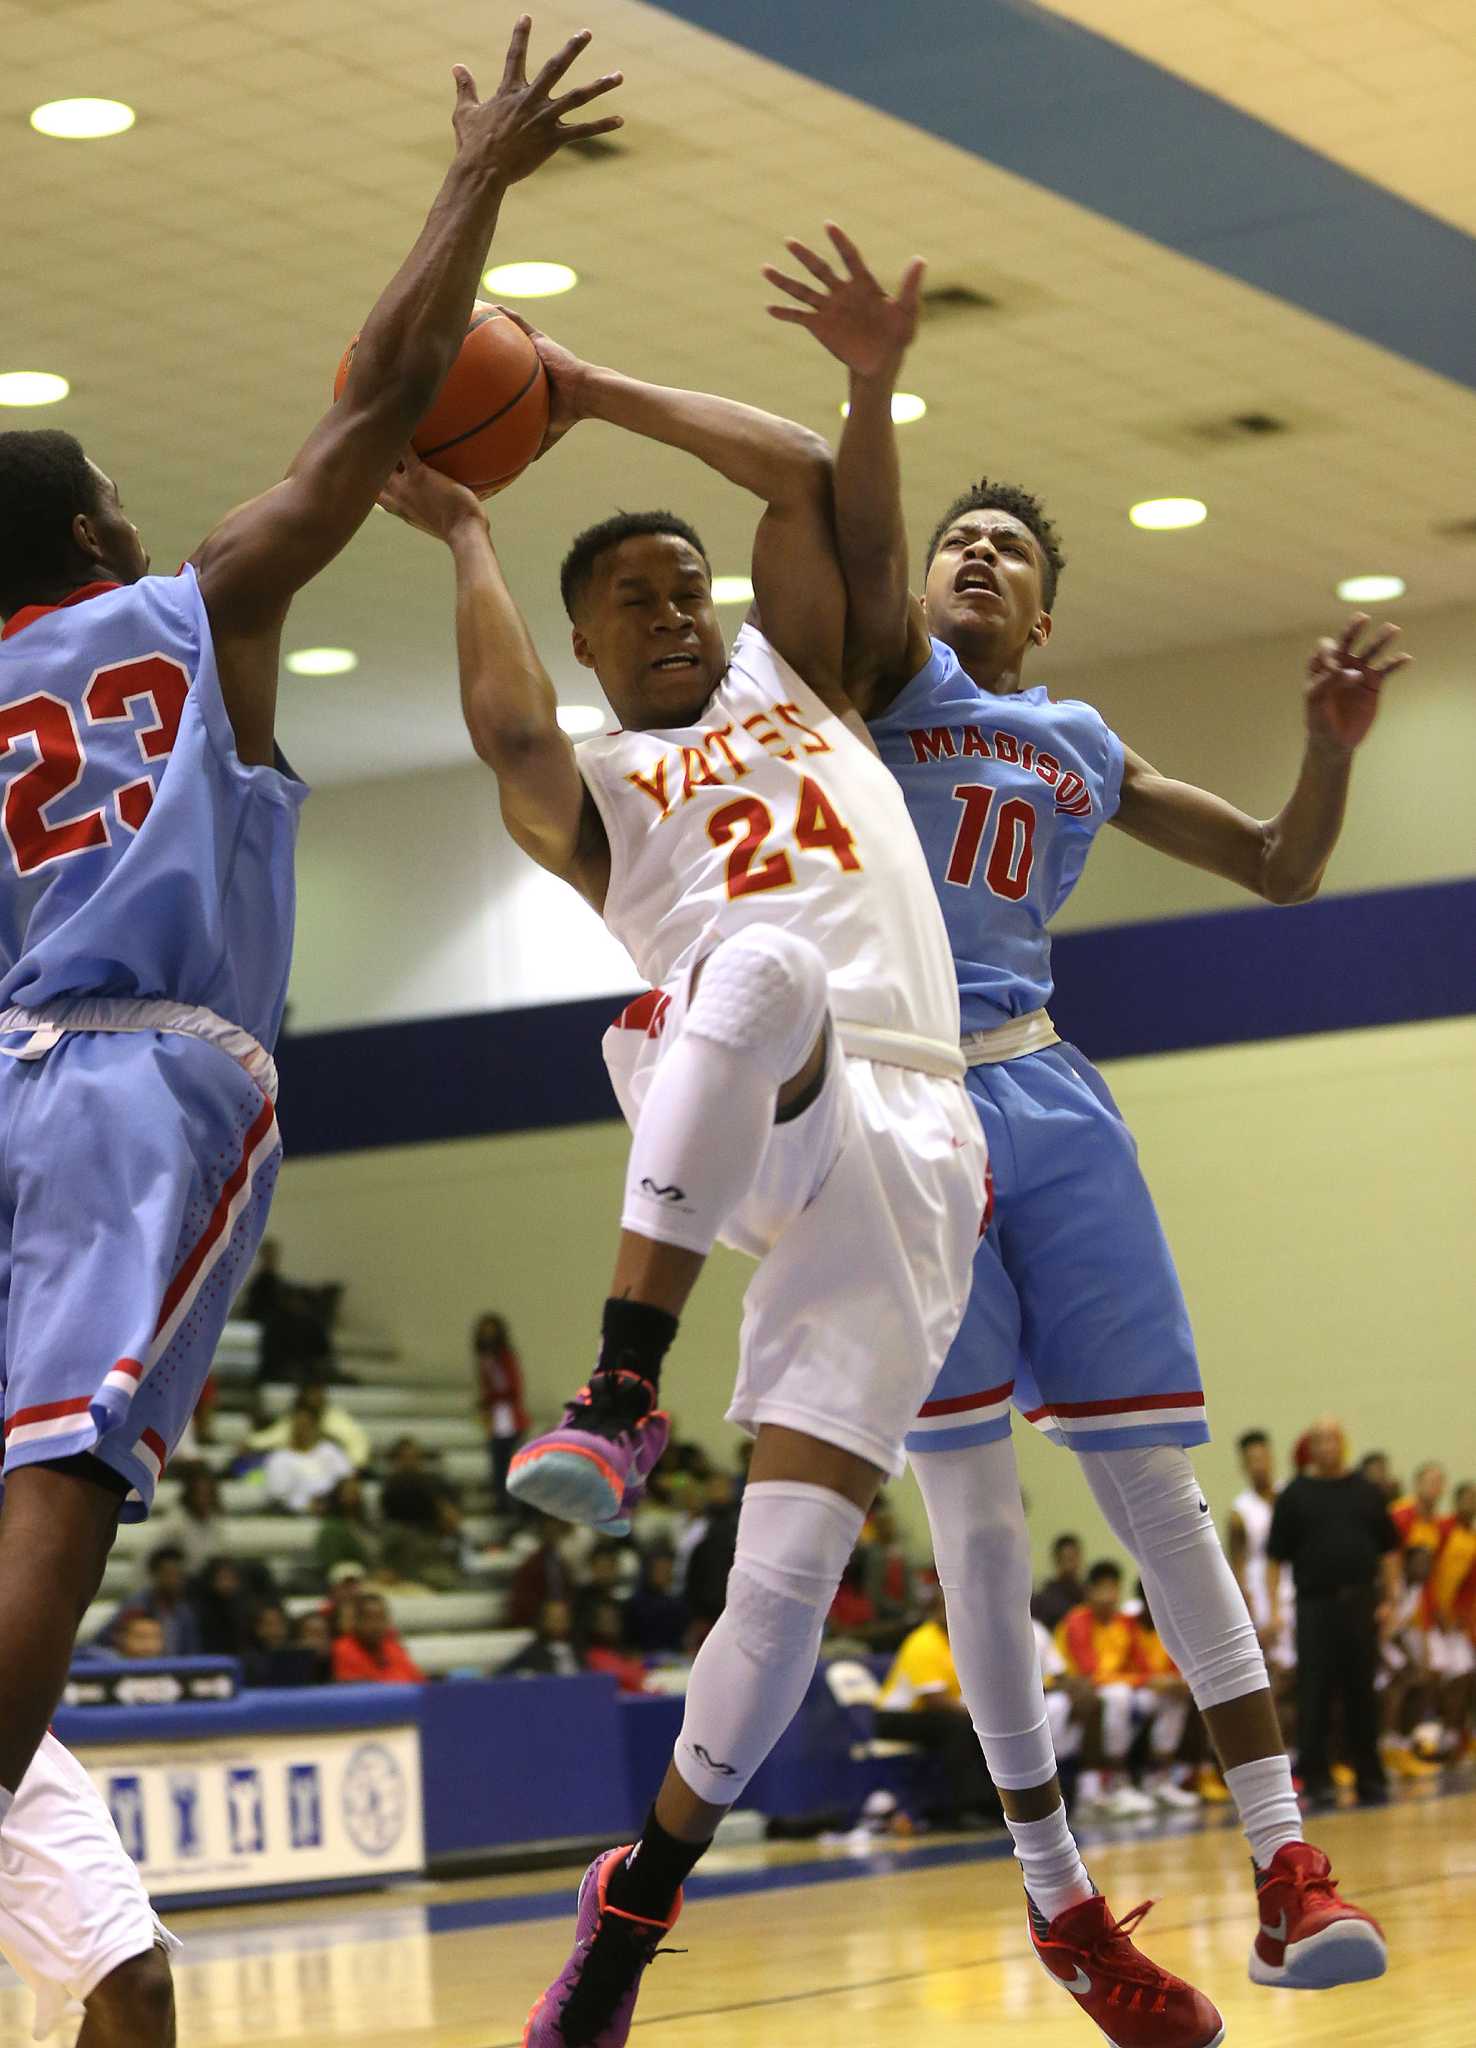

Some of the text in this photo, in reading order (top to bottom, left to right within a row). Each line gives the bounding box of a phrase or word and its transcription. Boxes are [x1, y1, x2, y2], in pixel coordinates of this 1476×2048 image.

[625, 703, 833, 823] YATES
[704, 773, 865, 903] 24
[944, 783, 1037, 902] 10
